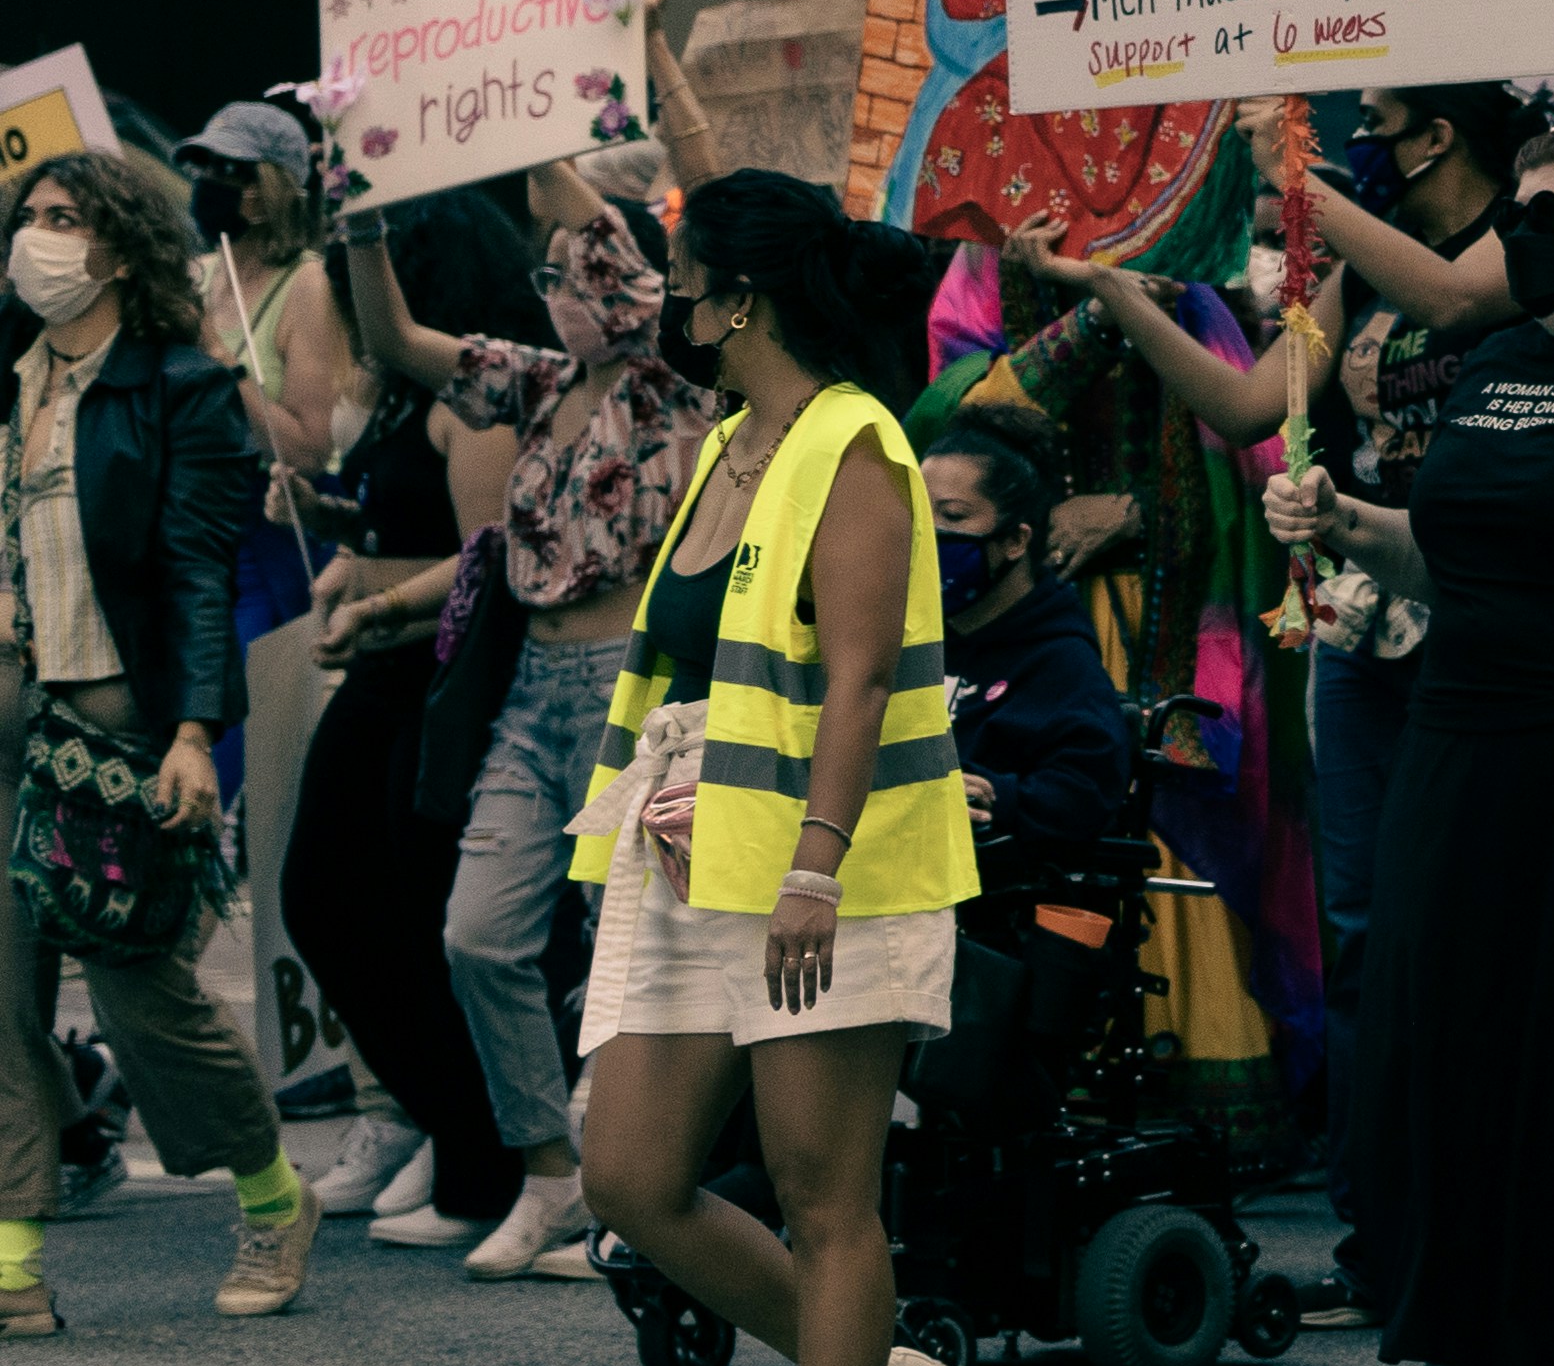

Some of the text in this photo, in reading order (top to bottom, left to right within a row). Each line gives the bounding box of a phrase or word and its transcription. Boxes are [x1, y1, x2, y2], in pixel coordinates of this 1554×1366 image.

[1088, 10, 1388, 78] support at 6 weeks
[420, 59, 556, 146] rights
[1481, 383, 1494, 395] A
[1486, 399, 1503, 411] IS
[1505, 401, 1534, 415] HER
